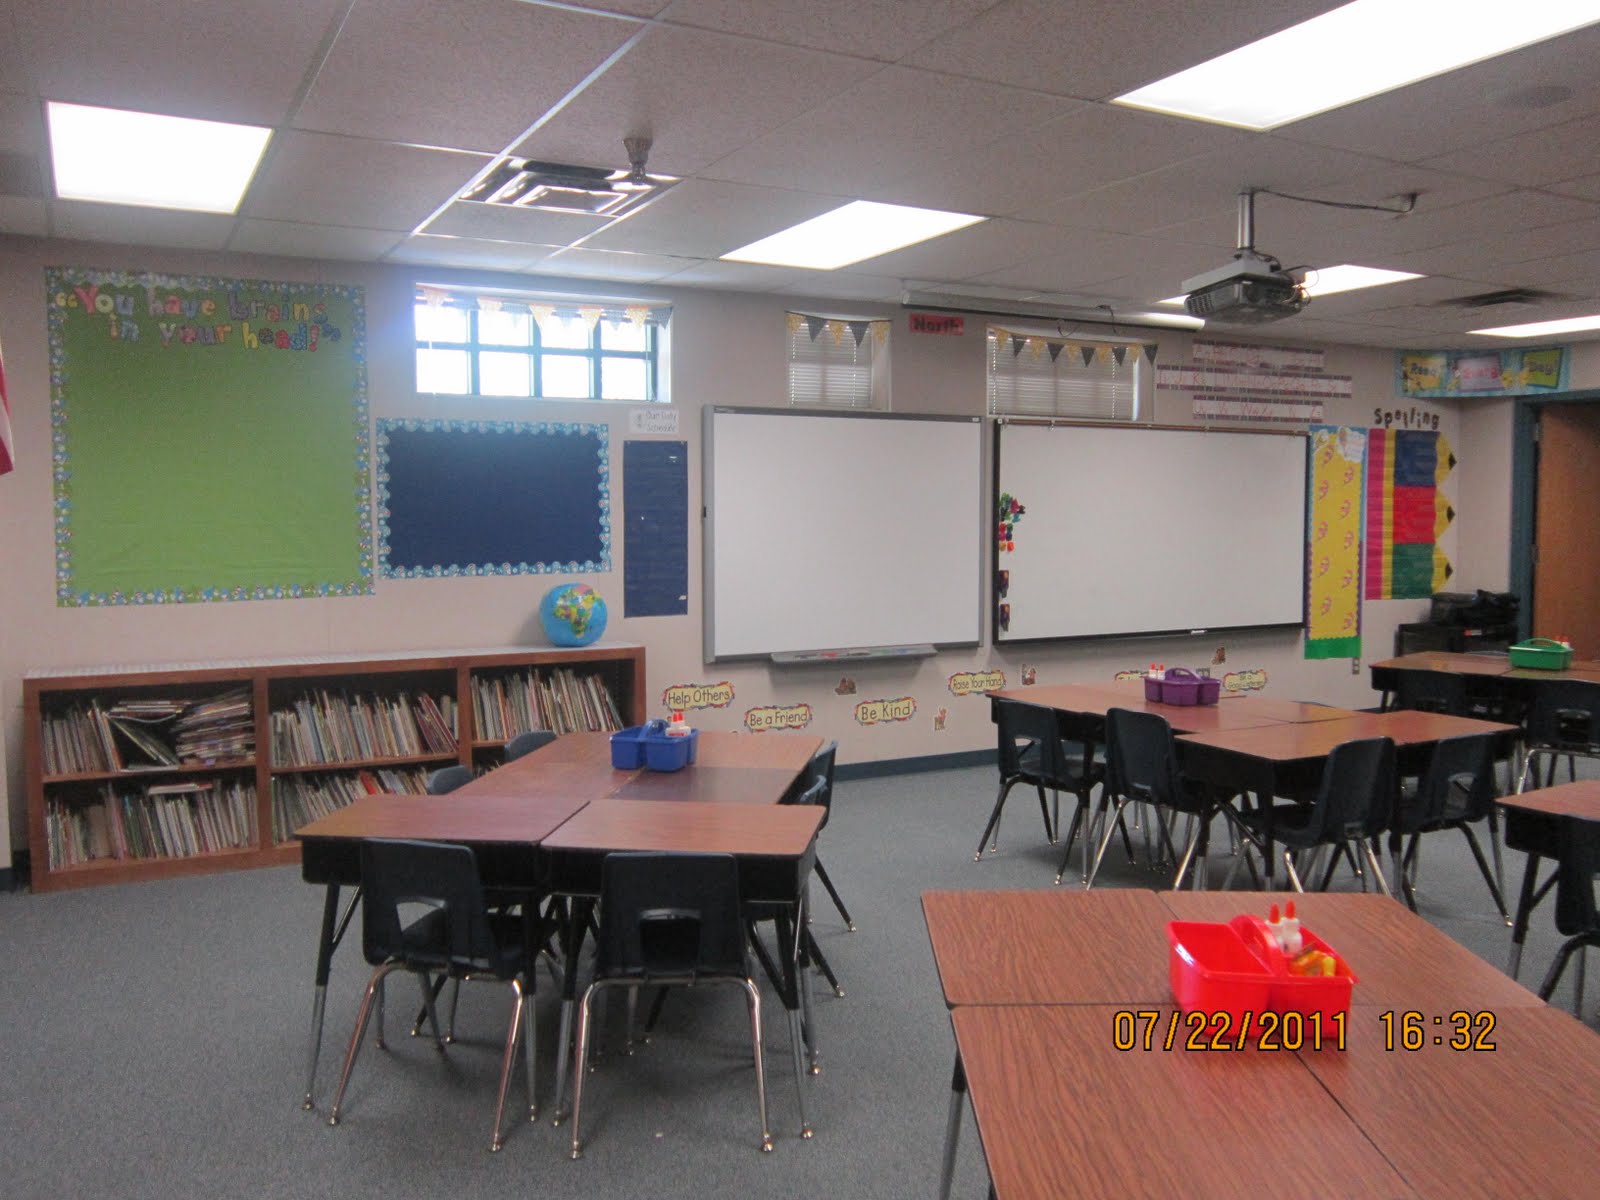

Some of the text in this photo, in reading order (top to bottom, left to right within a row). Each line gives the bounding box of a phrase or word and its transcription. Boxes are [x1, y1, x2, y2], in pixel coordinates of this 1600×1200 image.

[108, 313, 140, 342] in
[160, 322, 232, 348] your
[1374, 407, 1440, 430] Spelling
[971, 676, 985, 688] Your
[668, 689, 730, 708] Help Others
[750, 711, 808, 726] Be a Friend
[861, 701, 911, 720] Be Kind
